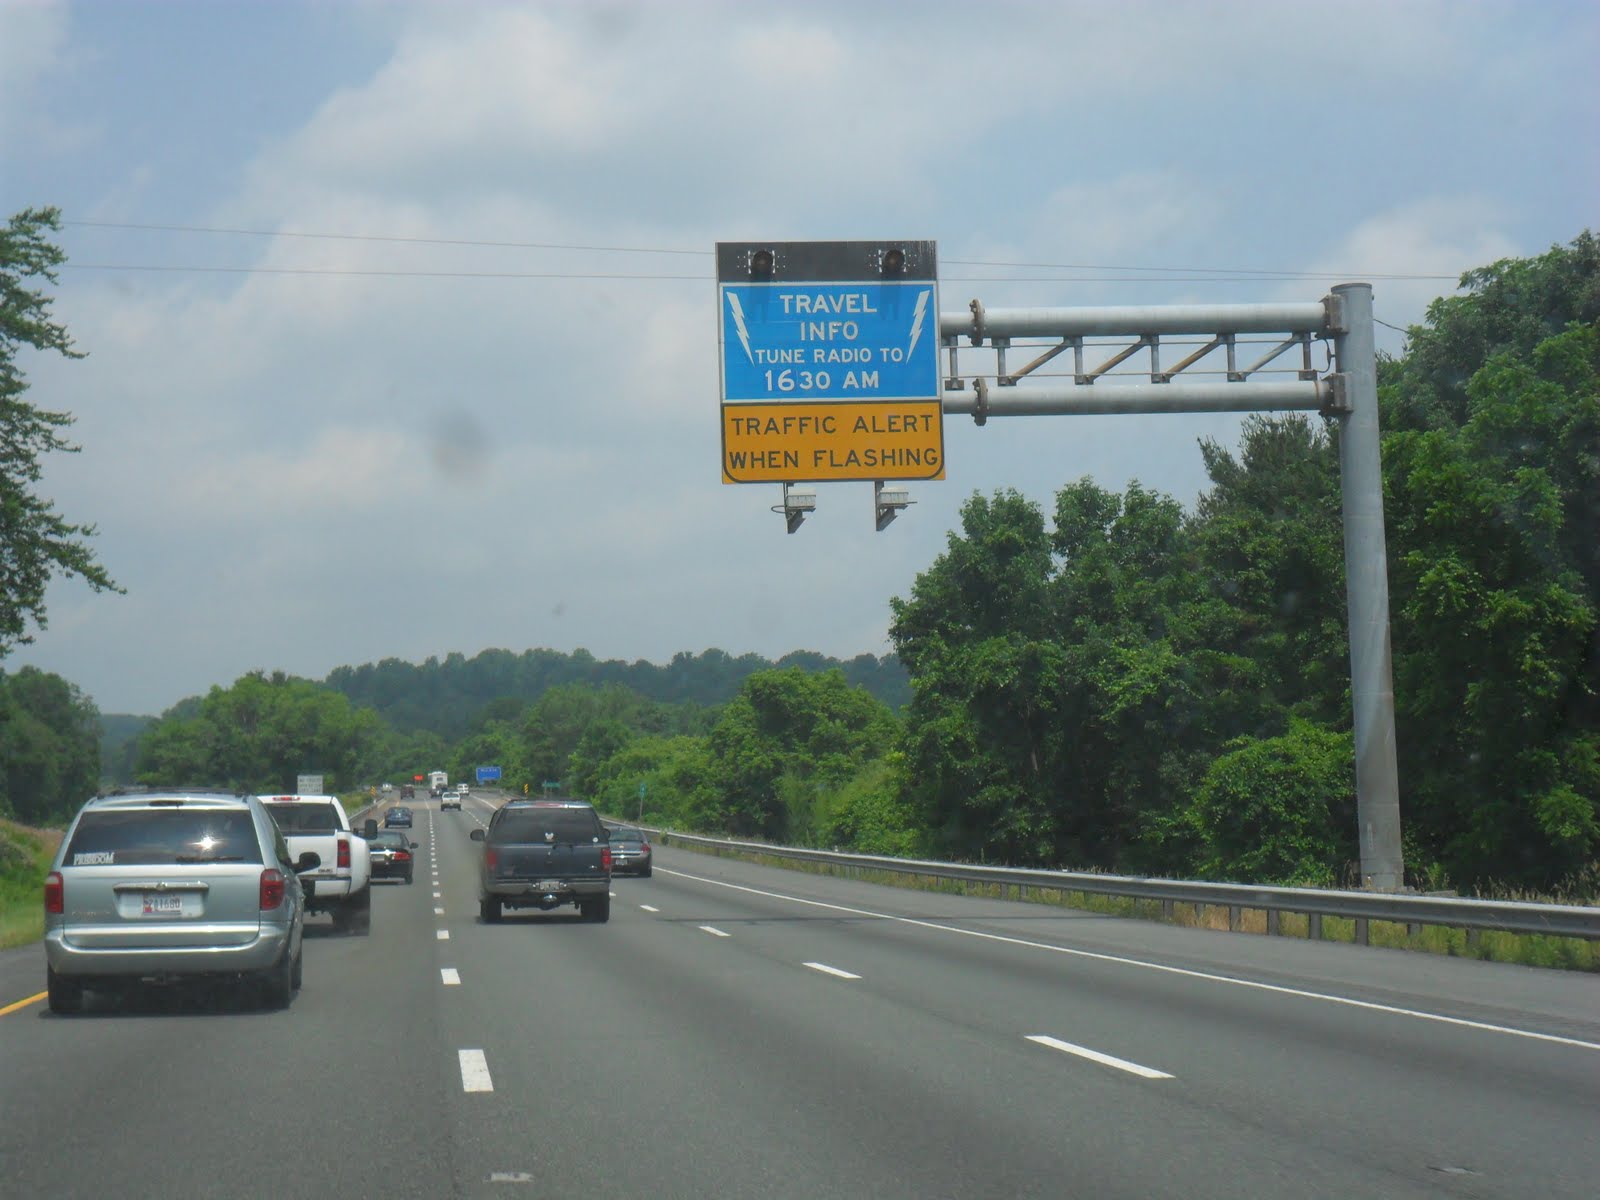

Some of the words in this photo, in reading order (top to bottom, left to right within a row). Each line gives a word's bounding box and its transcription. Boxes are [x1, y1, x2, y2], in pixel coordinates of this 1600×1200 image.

[780, 294, 877, 314] TRAVEL
[800, 321, 858, 341] INFO
[755, 349, 805, 364] TUNE
[814, 348, 872, 363] RADIO
[880, 348, 903, 362] TO
[765, 369, 831, 391] 1630
[842, 371, 879, 389] AM
[731, 416, 837, 436] TRAFFIC
[852, 414, 933, 433] ALERT
[729, 451, 799, 469] WHEN
[813, 448, 938, 468] FLASHING
